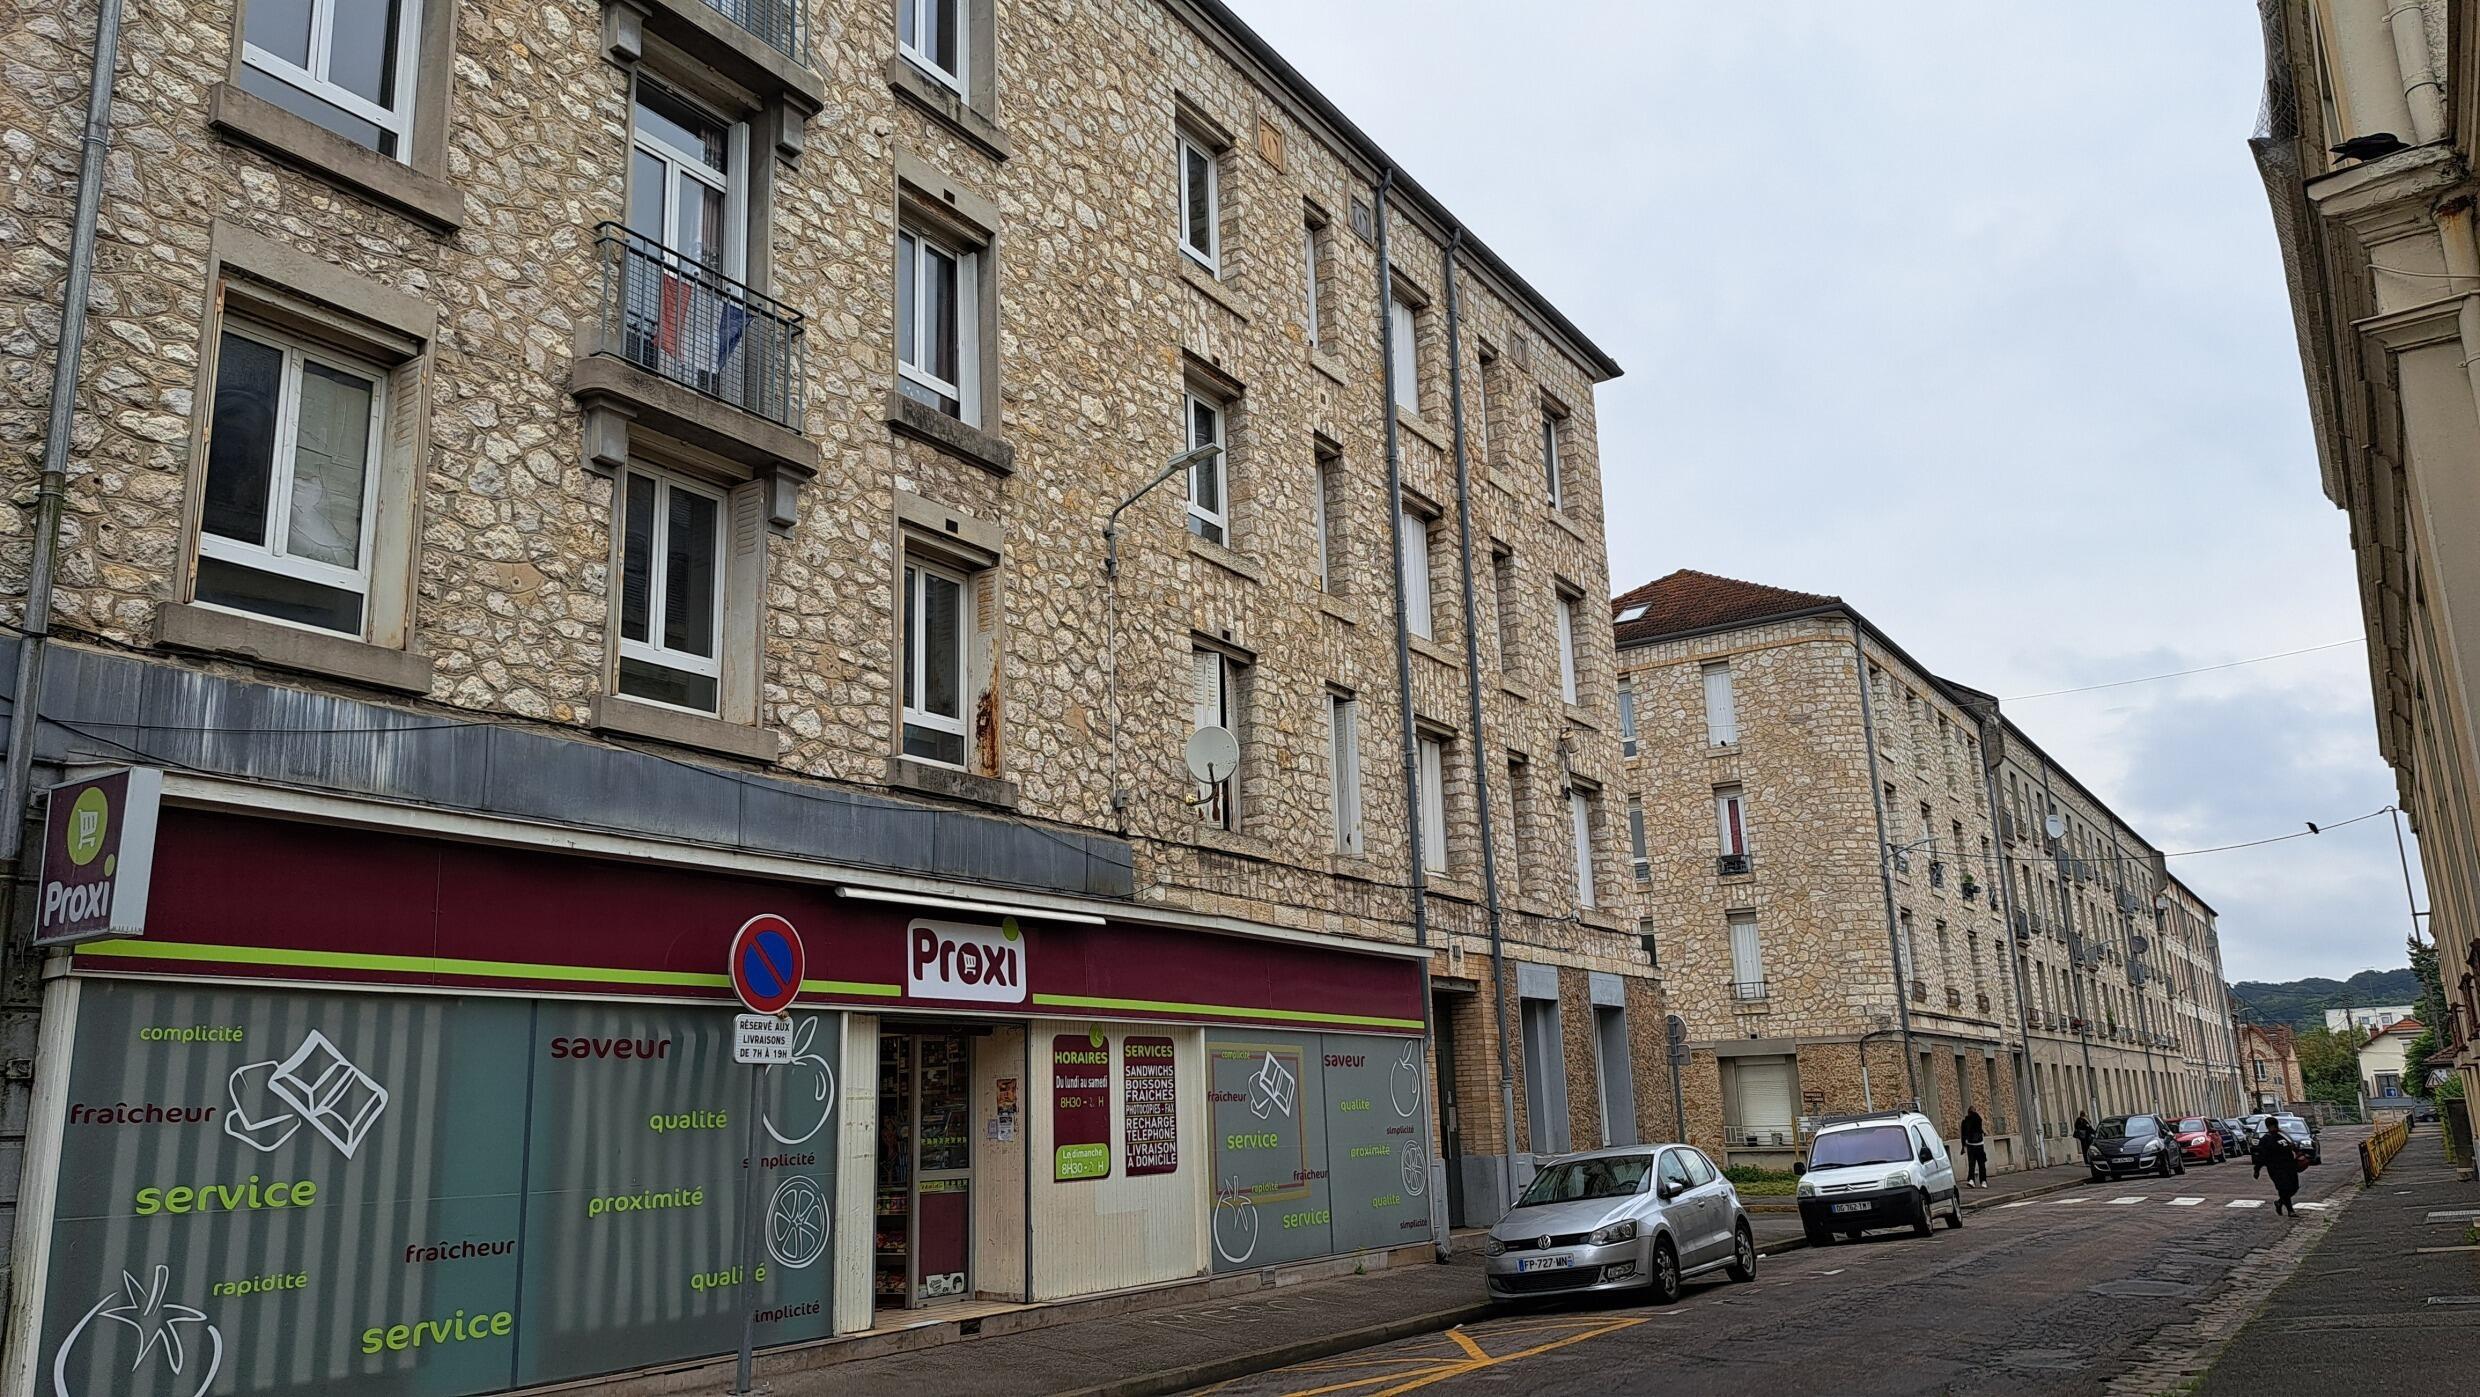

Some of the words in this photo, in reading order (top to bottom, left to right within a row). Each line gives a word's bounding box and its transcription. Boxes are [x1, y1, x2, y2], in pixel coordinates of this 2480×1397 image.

[740, 1019, 772, 1031] RÉSERVÉ
[775, 1023, 790, 1032] AUX
[140, 1026, 244, 1044] complicité
[743, 1034, 785, 1045] LIVRAISONS
[551, 1035, 671, 1060] saveur
[740, 1048, 749, 1057] DE
[753, 1049, 762, 1057] 7H
[773, 1050, 787, 1058] 19H
[1125, 1045, 1173, 1057] SERVICES
[1054, 1051, 1108, 1065] HORAIRES
[1324, 1054, 1365, 1068] saveur
[1125, 1065, 1173, 1077] SANDWICHS
[1056, 1075, 1064, 1089] Du
[1065, 1075, 1079, 1088] lundi
[1080, 1078, 1087, 1088] au
[1088, 1075, 1108, 1088] samedi
[1125, 1079, 1174, 1090] BOISSONS
[1060, 1096, 1081, 1108] 8H30
[1125, 1089, 1174, 1101] FRAICHES
[1207, 1088, 1247, 1102] fraîcheur
[1125, 1104, 1160, 1115] PHOTOCOPIES
[1165, 1103, 1174, 1113] FAX
[1340, 1098, 1370, 1112] qualité
[70, 1103, 216, 1125] fraîcheur
[649, 1108, 728, 1133] qualité
[1126, 1117, 1175, 1129] RECHARGE
[1126, 1128, 1175, 1141] TELEPHONE
[1227, 1130, 1278, 1149] service
[1072, 1147, 1103, 1159] dimanche
[1127, 1141, 1176, 1156] LIVRAISON
[742, 1152, 815, 1170] smplicité
[1128, 1157, 1134, 1168] A
[1136, 1153, 1177, 1167] DOMICILE
[1293, 1169, 1329, 1180] fraîcheur
[135, 1175, 317, 1215] service
[588, 1185, 704, 1217] proximité
[1372, 1192, 1400, 1208] qualité
[1283, 1208, 1330, 1229] service
[405, 1240, 515, 1264] fraîcheur
[213, 1271, 309, 1297] rapidité
[690, 1262, 766, 1292] qualié
[753, 1300, 820, 1323] implicité
[362, 1309, 512, 1354] service
